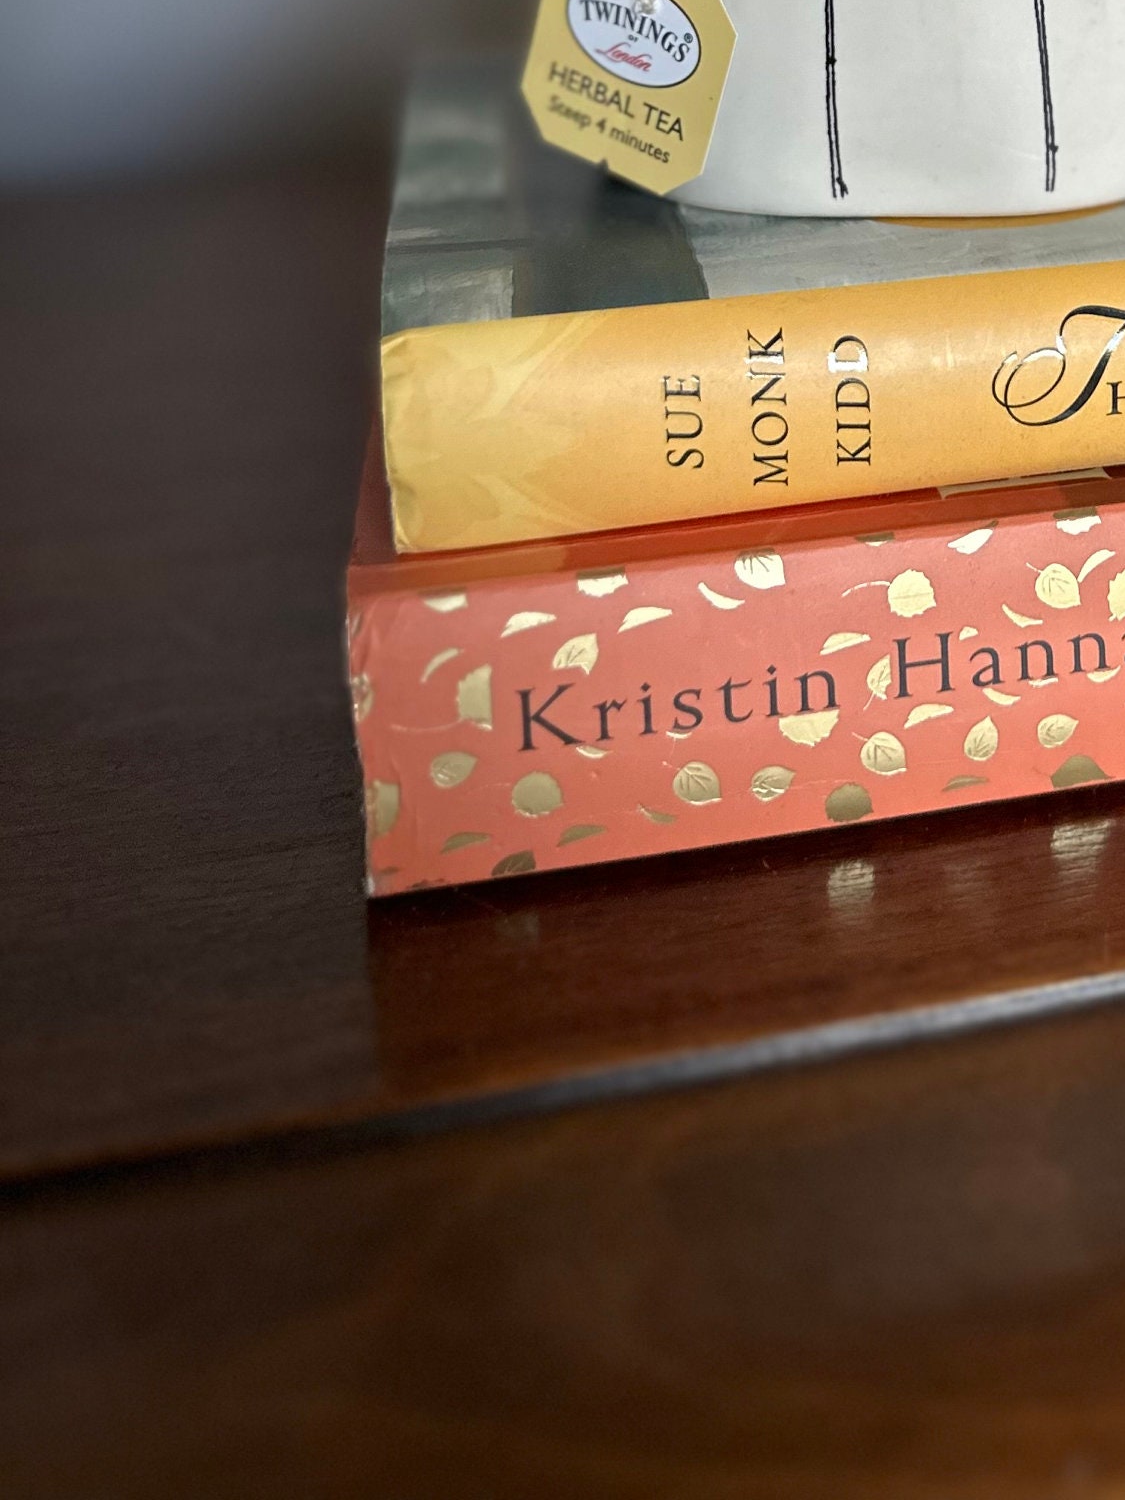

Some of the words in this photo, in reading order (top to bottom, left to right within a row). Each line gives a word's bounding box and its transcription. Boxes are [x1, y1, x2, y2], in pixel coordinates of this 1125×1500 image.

[595, 41, 652, 72] London
[548, 61, 635, 119] HERBAL
[643, 101, 684, 141] TEA
[549, 94, 592, 130] Steep
[595, 117, 607, 134] 4
[609, 128, 671, 164] minutes
[663, 374, 705, 469] SUE
[746, 327, 789, 487] MONK
[827, 334, 872, 467] KIDD
[517, 664, 839, 752] Kristin
